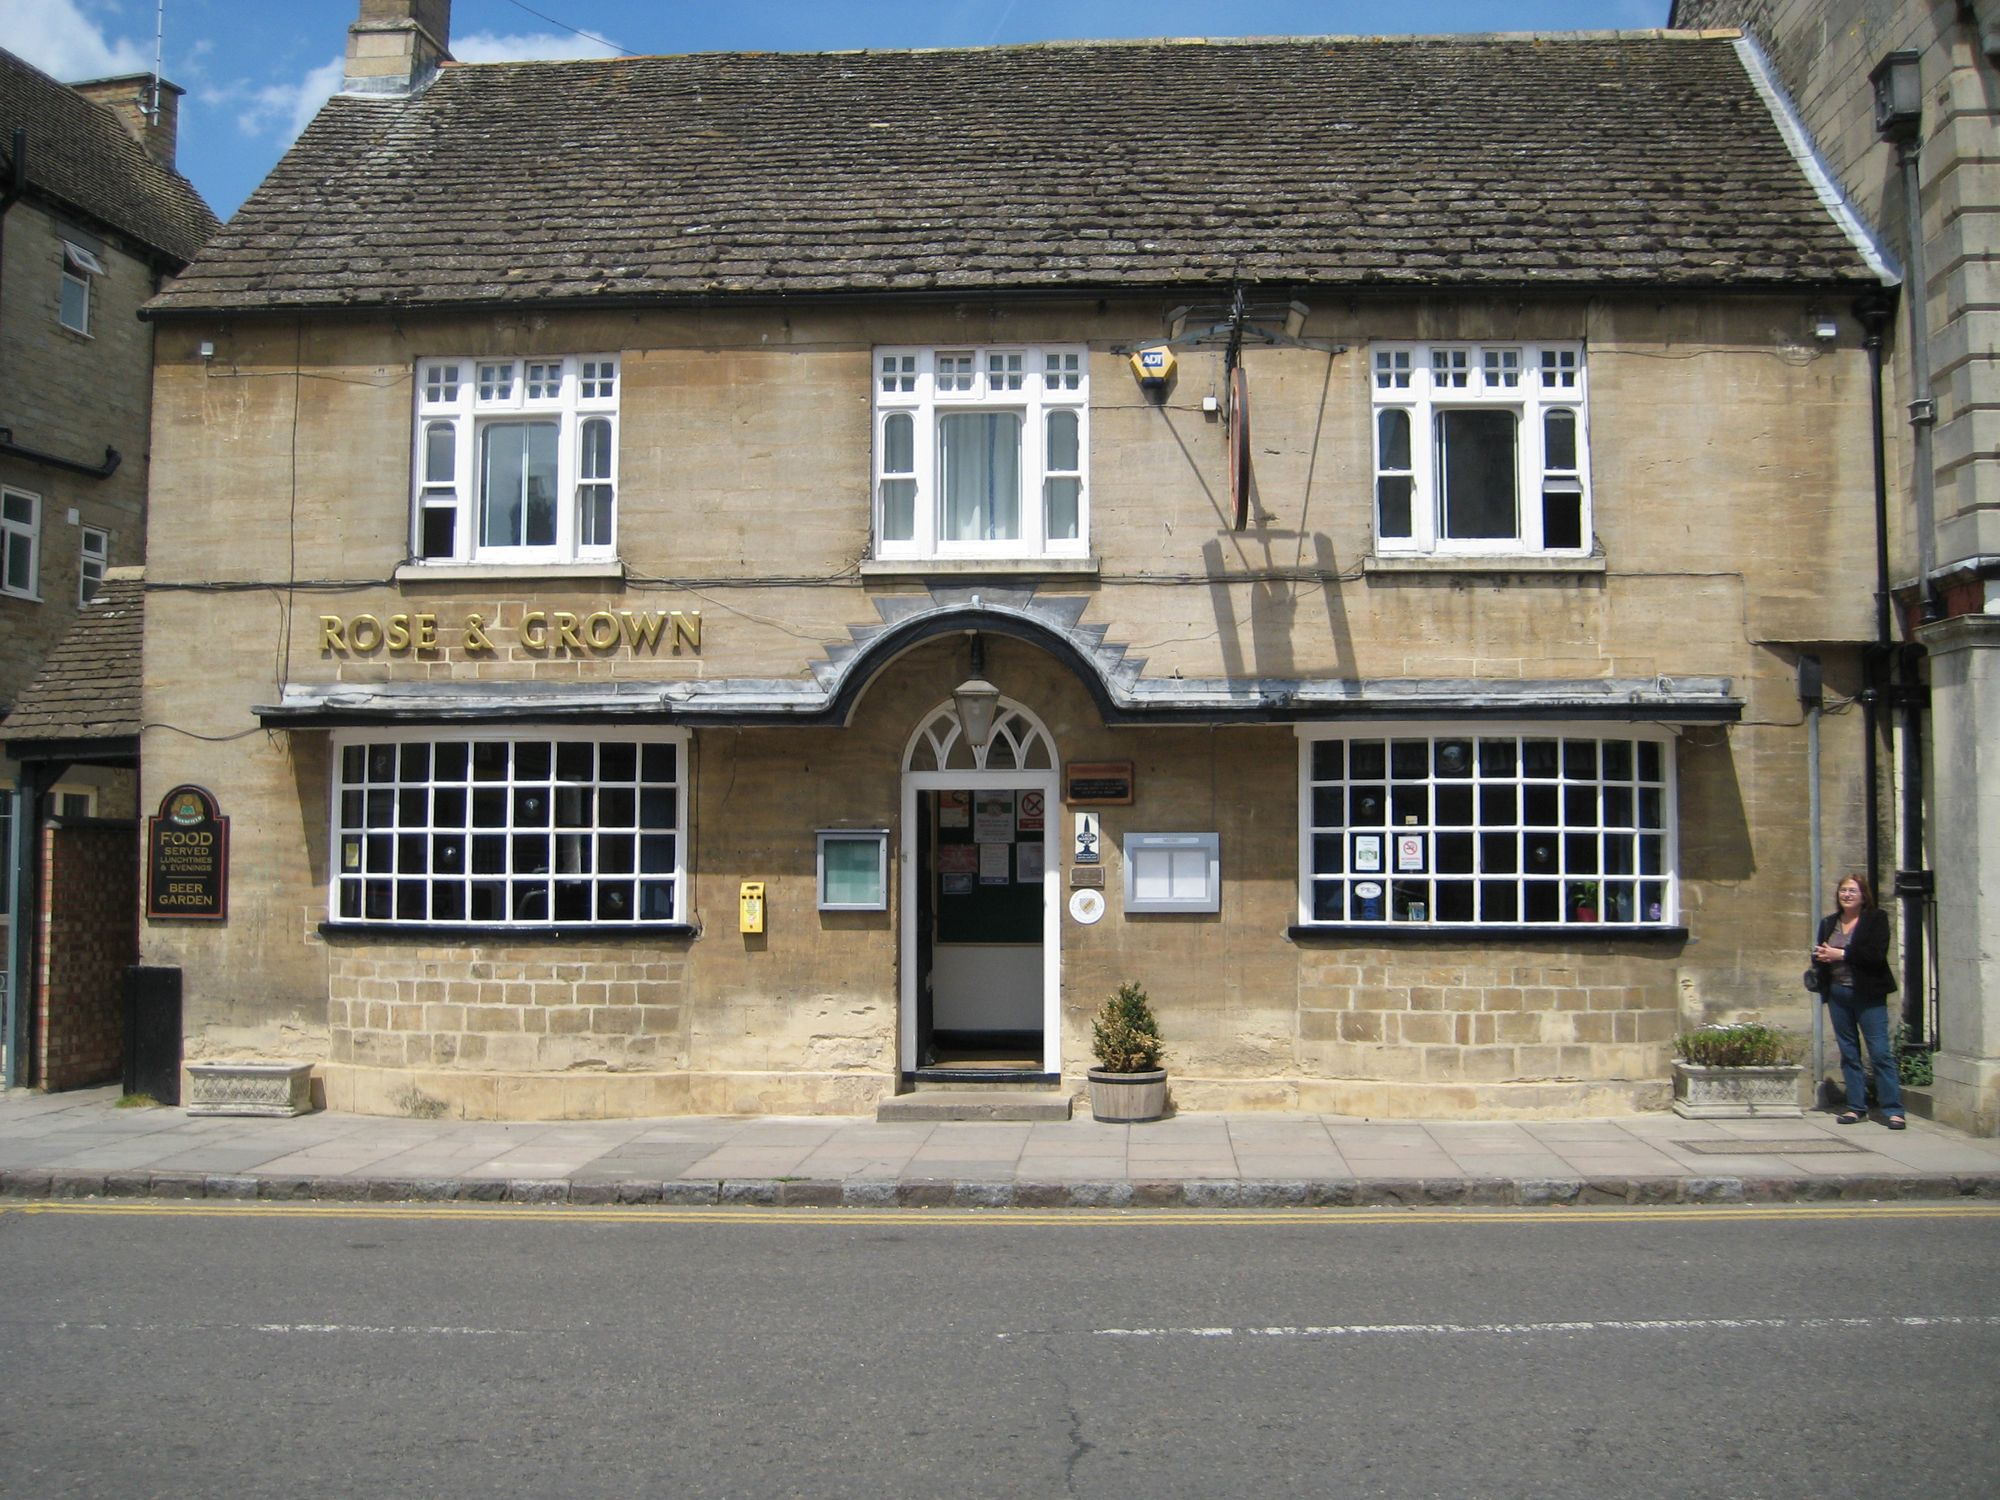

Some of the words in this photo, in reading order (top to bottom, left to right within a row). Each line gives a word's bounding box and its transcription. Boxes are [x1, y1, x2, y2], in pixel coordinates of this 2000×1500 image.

[1143, 354, 1162, 365] ADT
[318, 613, 438, 651] ROSE
[463, 613, 496, 651] &
[518, 610, 702, 651] CROWN
[160, 831, 213, 847] FOOD
[164, 847, 209, 856] SERVED
[170, 864, 213, 872] EVENINGS
[169, 883, 203, 893] BEER
[159, 895, 213, 905] GARDEN
